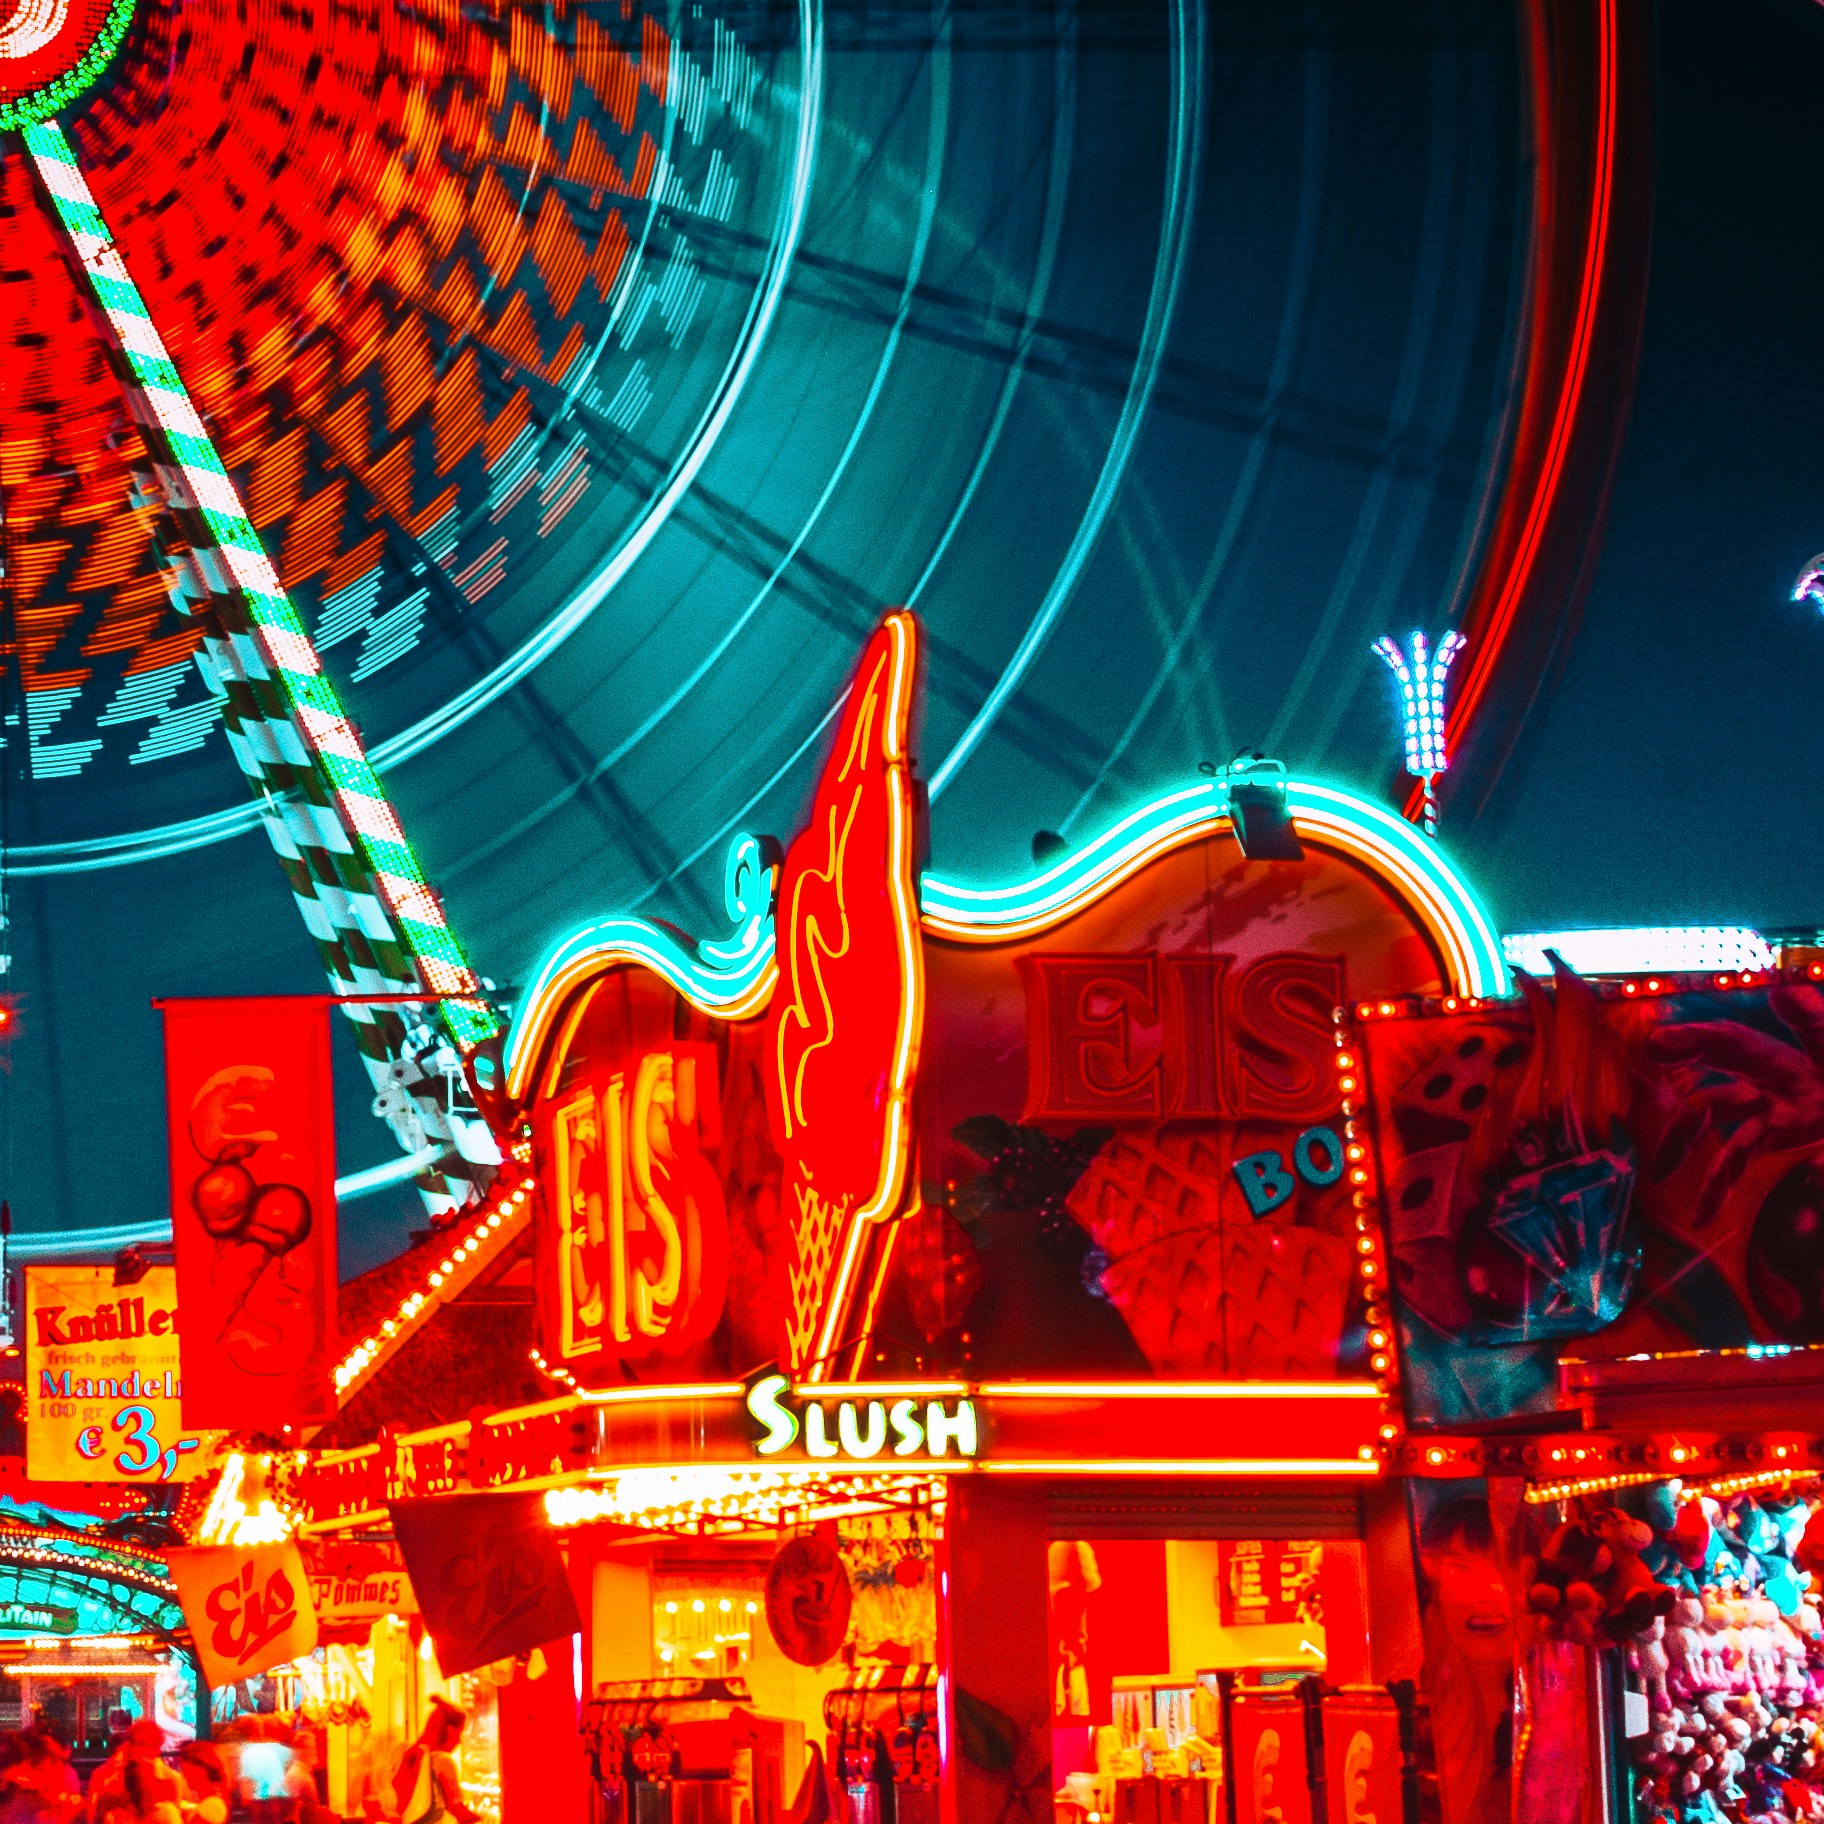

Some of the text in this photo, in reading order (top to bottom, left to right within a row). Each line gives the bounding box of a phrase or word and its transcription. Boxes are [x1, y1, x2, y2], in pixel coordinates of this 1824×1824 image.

[1012, 951, 1348, 1124] EIS
[548, 1044, 706, 1358] EIS
[47, 1350, 178, 1367] frisch gebrannt
[40, 1402, 108, 1422] 100 gr.
[746, 1375, 977, 1459] SLUSH
[205, 1559, 296, 1665] Eis
[313, 1578, 401, 1611] Pommes
